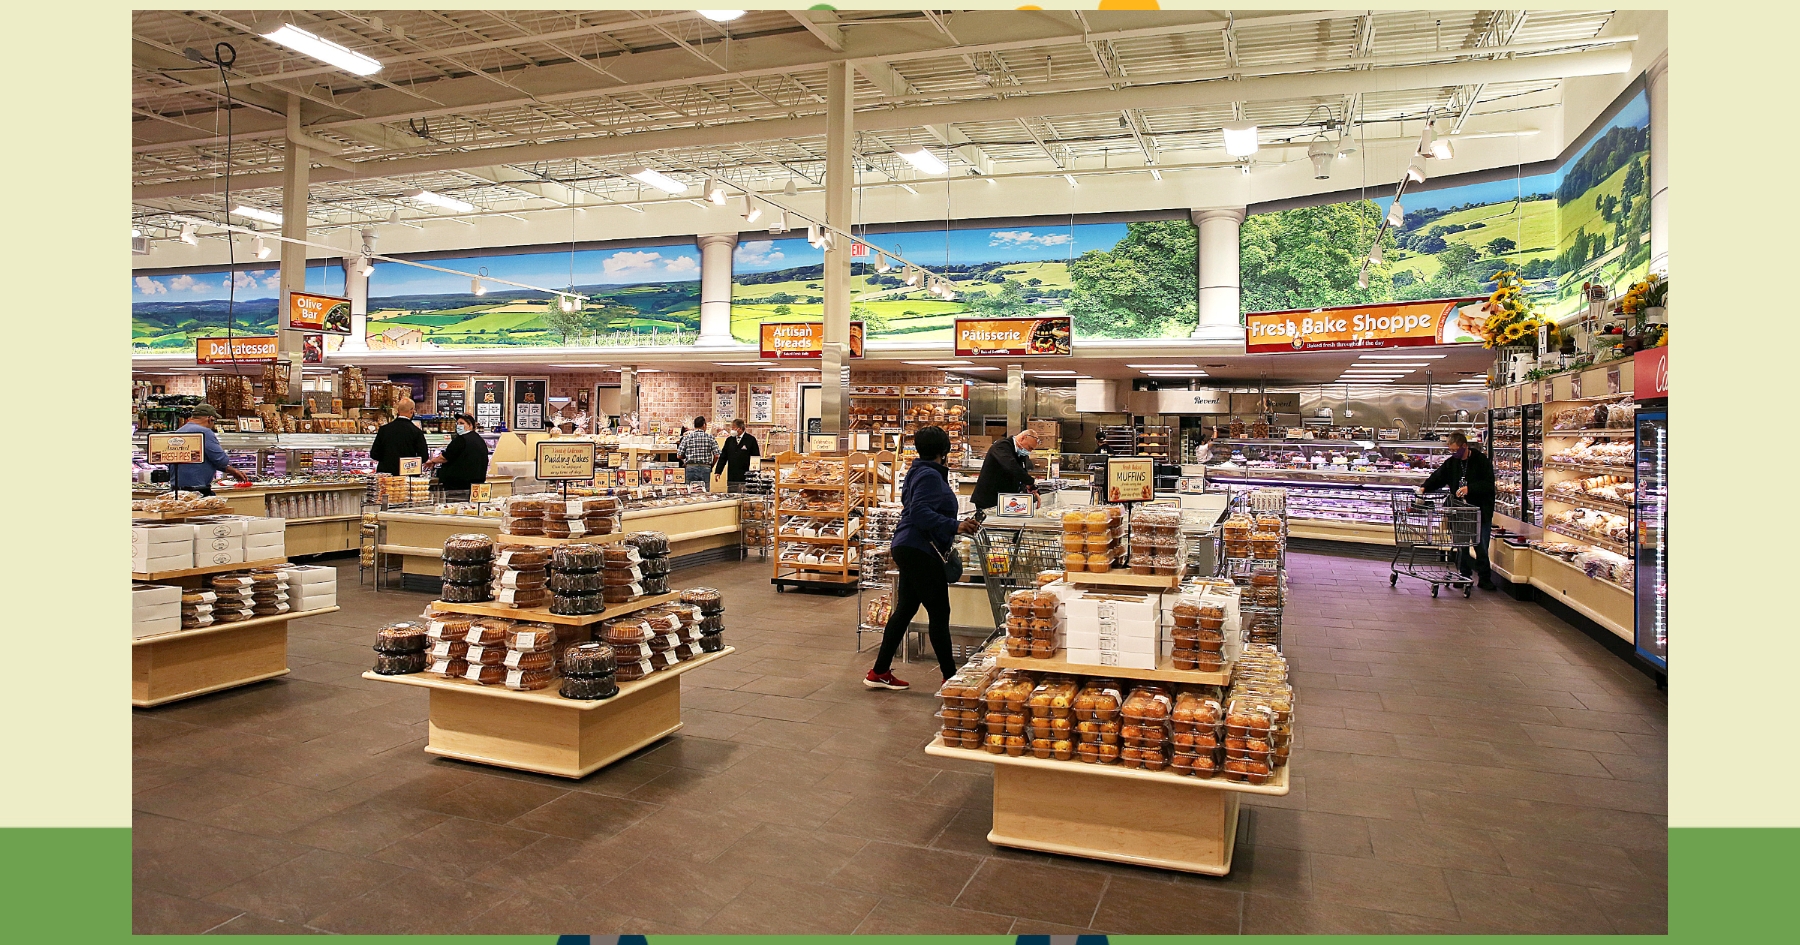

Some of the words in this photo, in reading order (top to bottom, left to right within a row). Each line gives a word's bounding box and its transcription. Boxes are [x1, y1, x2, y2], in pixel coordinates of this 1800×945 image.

[297, 297, 323, 310] Olive
[302, 308, 318, 320] Bar
[1251, 318, 1297, 337] Fresh
[1302, 316, 1347, 334] Bake
[1353, 313, 1432, 334] Shoppe
[773, 327, 812, 337] Artisan
[962, 329, 1020, 341] Pâtisserie
[773, 337, 812, 348] Breads
[162, 452, 177, 461] FRESH
[544, 454, 571, 465] Pudding
[572, 453, 589, 463] Cakes
[1117, 471, 1146, 481] MUFFINS
